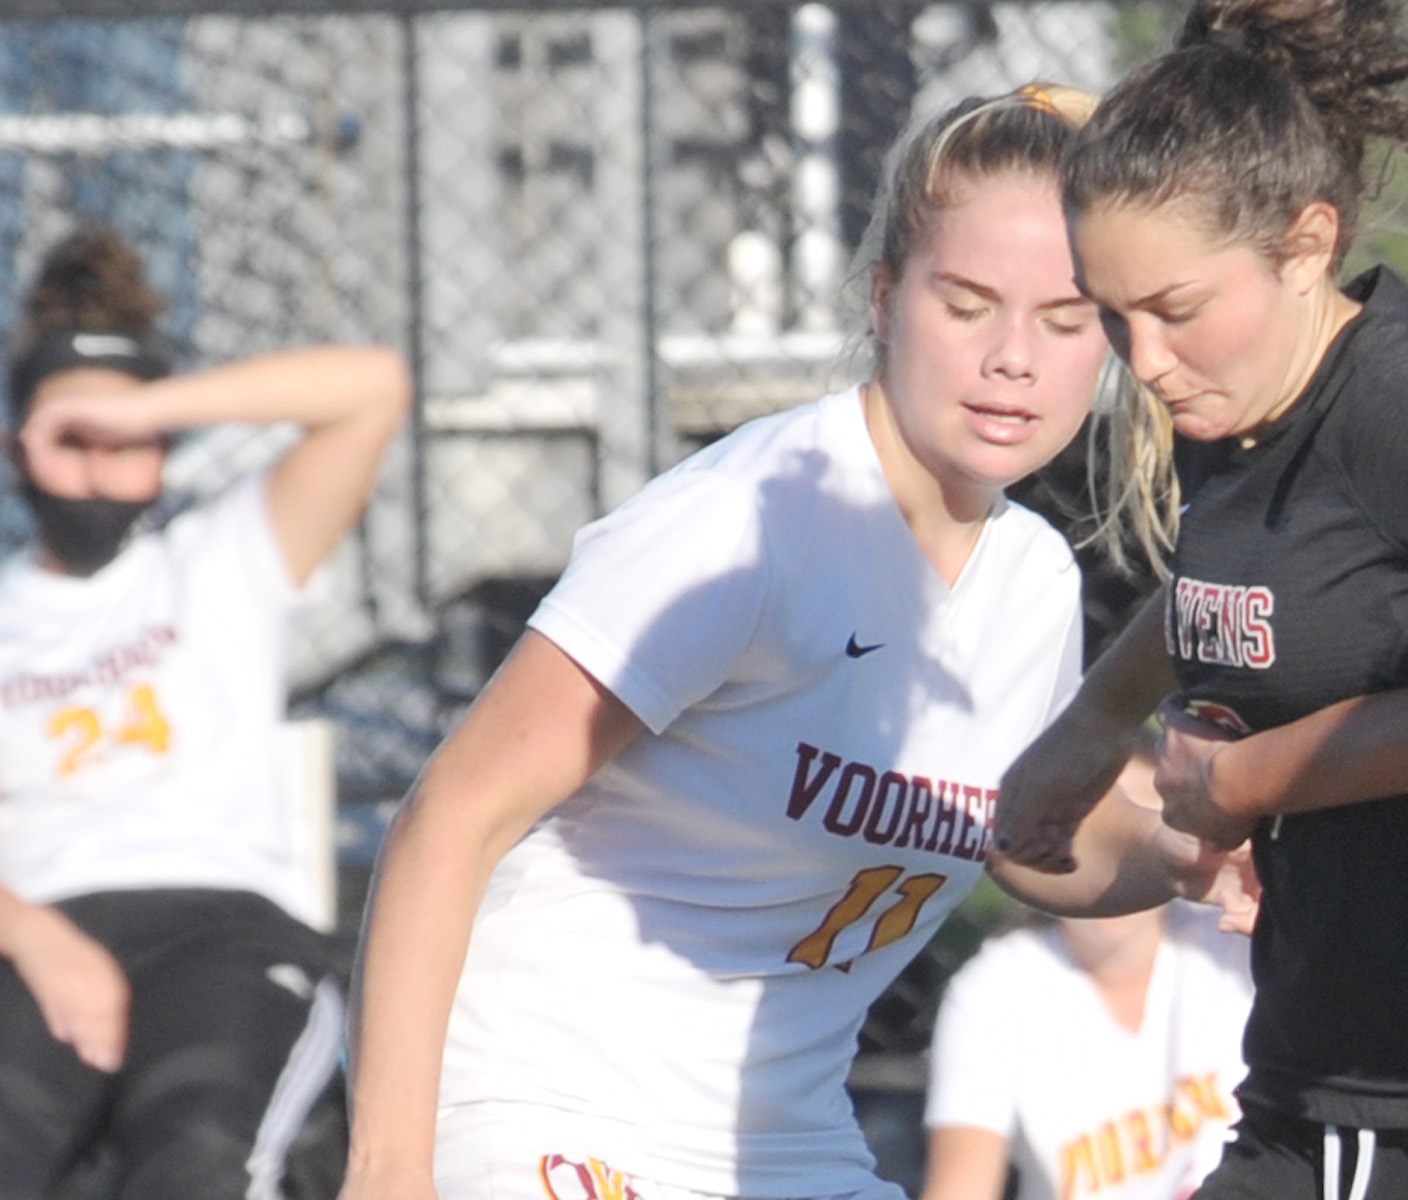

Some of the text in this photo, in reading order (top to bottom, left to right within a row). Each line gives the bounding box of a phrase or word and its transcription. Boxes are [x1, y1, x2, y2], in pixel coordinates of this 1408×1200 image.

[1165, 577, 1276, 669] VENS
[47, 681, 172, 774] 24
[785, 864, 948, 974] 11
